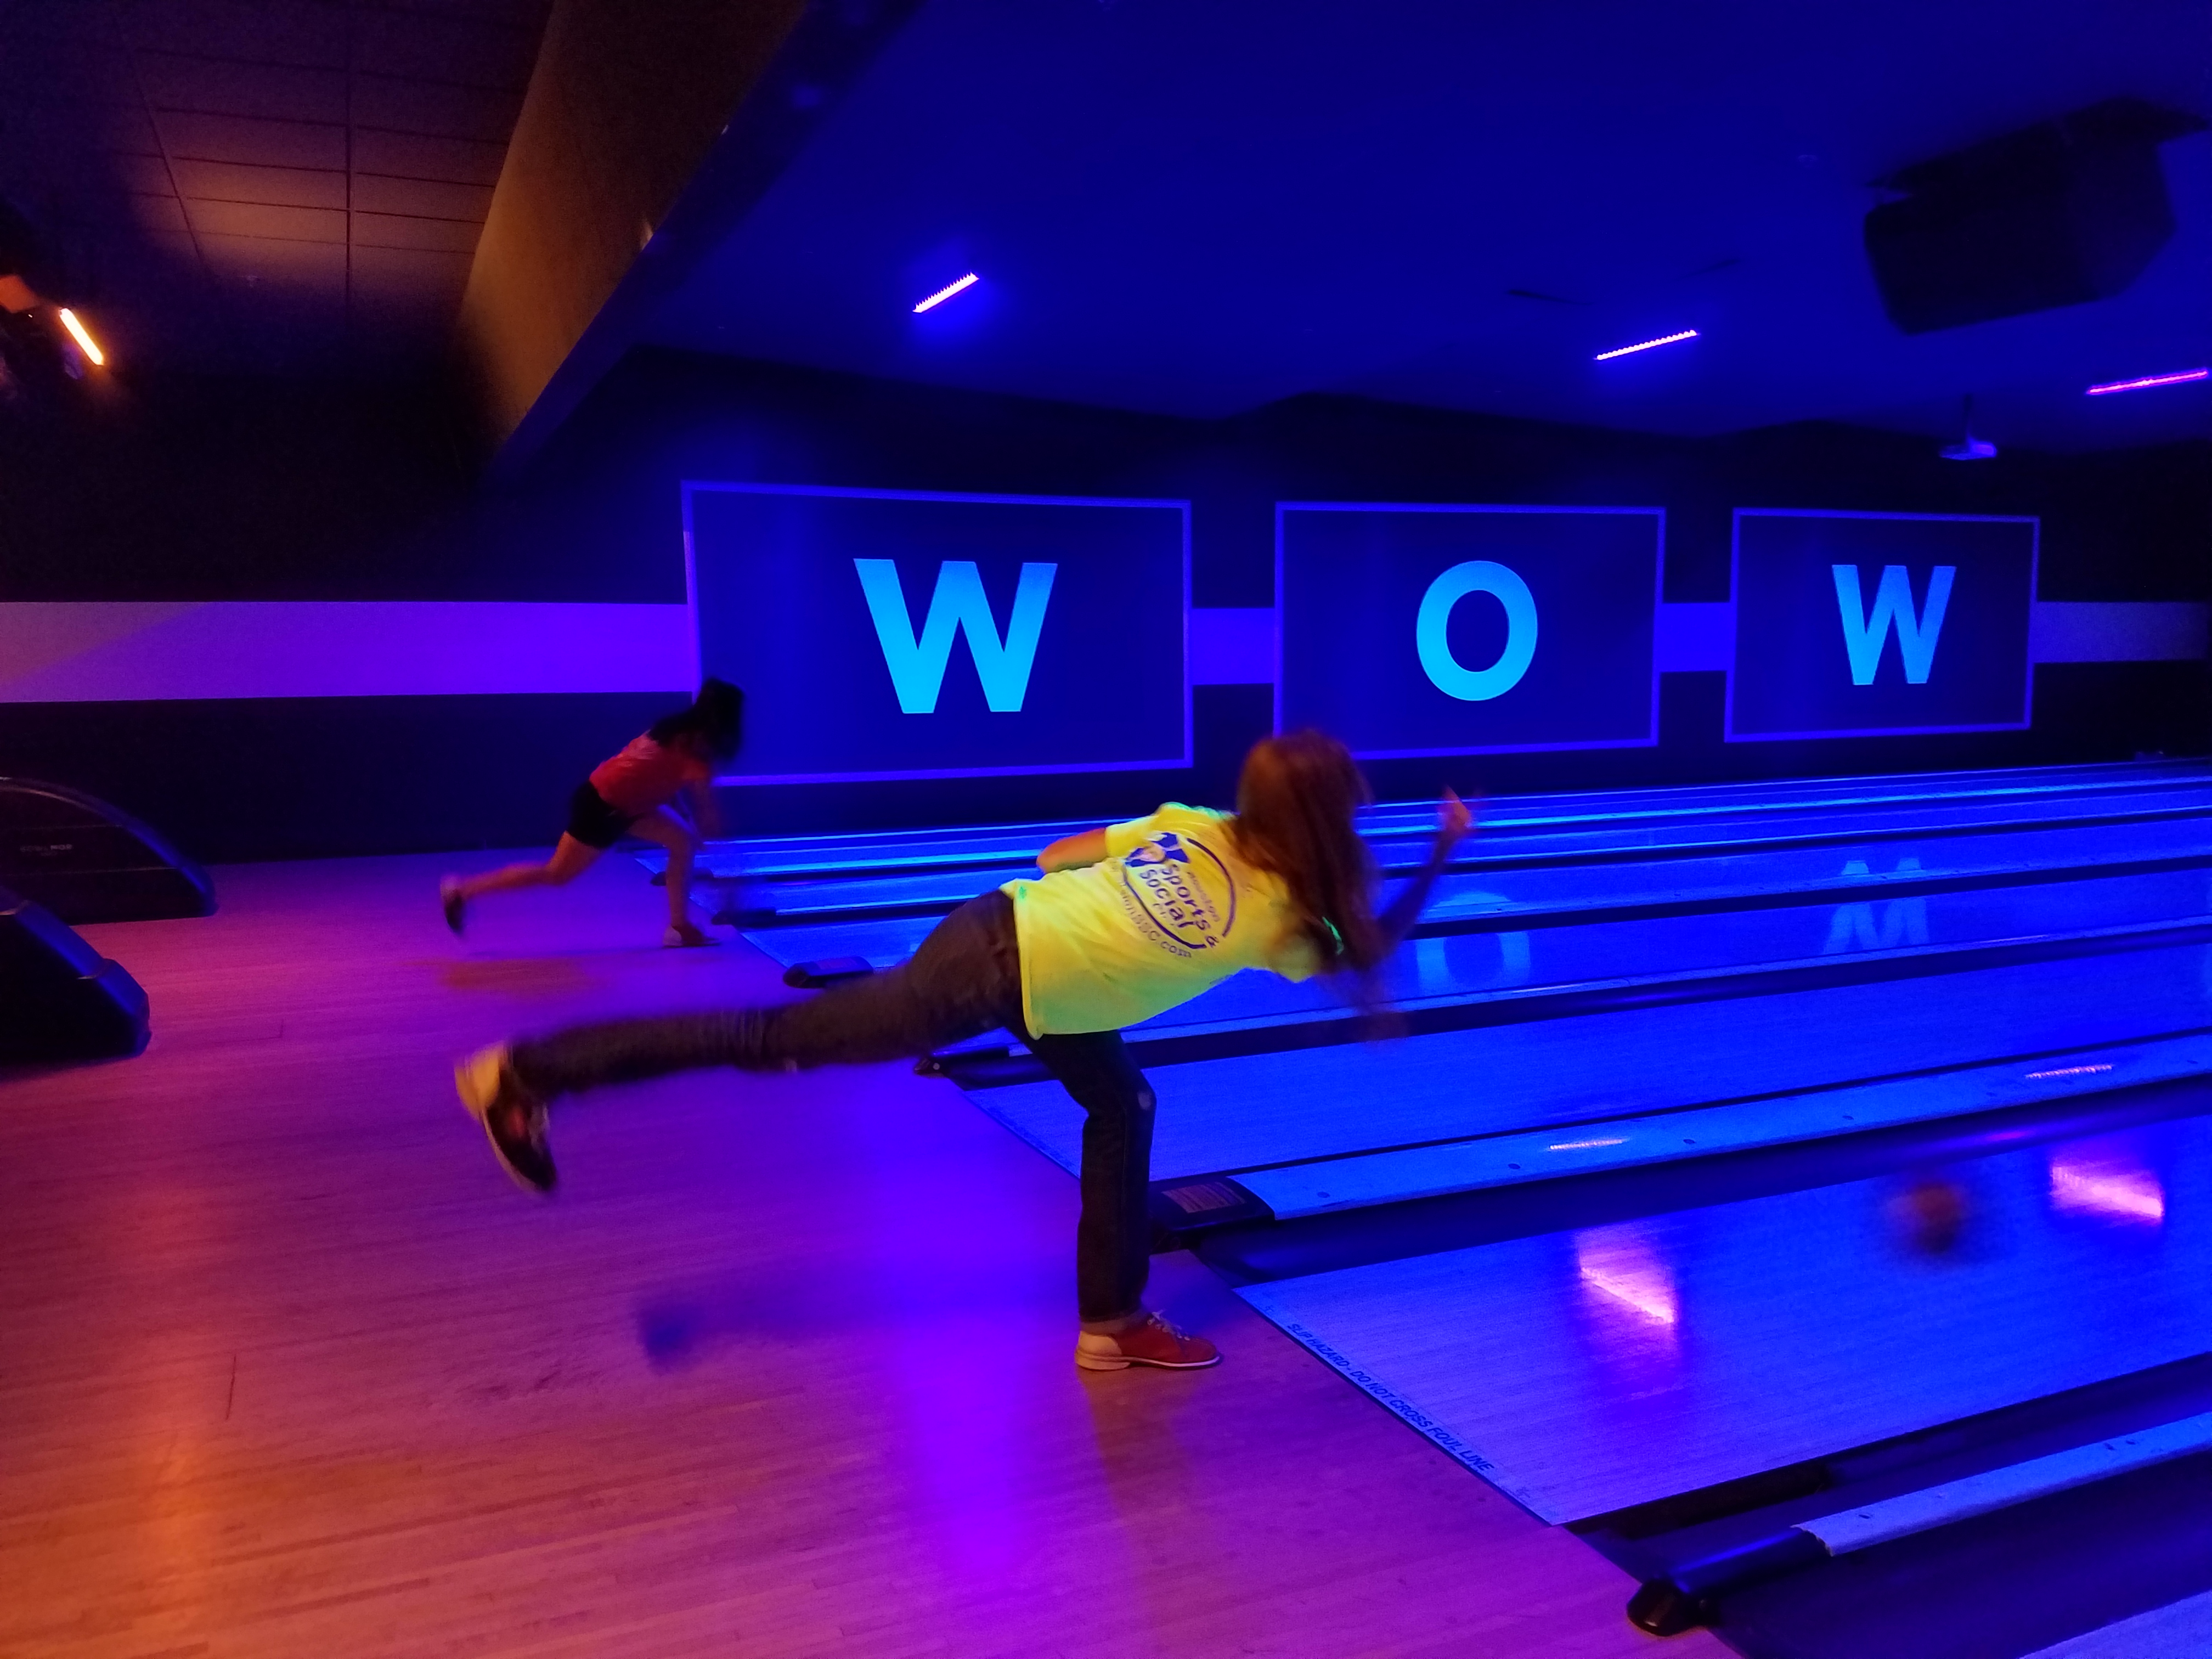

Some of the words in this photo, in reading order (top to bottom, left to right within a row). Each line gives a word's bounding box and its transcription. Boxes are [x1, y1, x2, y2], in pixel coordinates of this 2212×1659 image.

[854, 558, 1058, 714] W
[1415, 561, 1538, 702] O
[1831, 564, 1956, 686] W
[1139, 869, 1195, 928] Social
[1160, 864, 1211, 930] Sports
[1205, 935, 1219, 948] &
[1287, 1323, 1313, 1339] SLIP
[1306, 1338, 1350, 1367] HAZARD
[1350, 1370, 1372, 1383] DO
[1365, 1383, 1396, 1398] NOT
[1390, 1399, 1434, 1427] CROSS
[1427, 1427, 1463, 1452] FOUL
[1458, 1449, 1495, 1471] LINE
